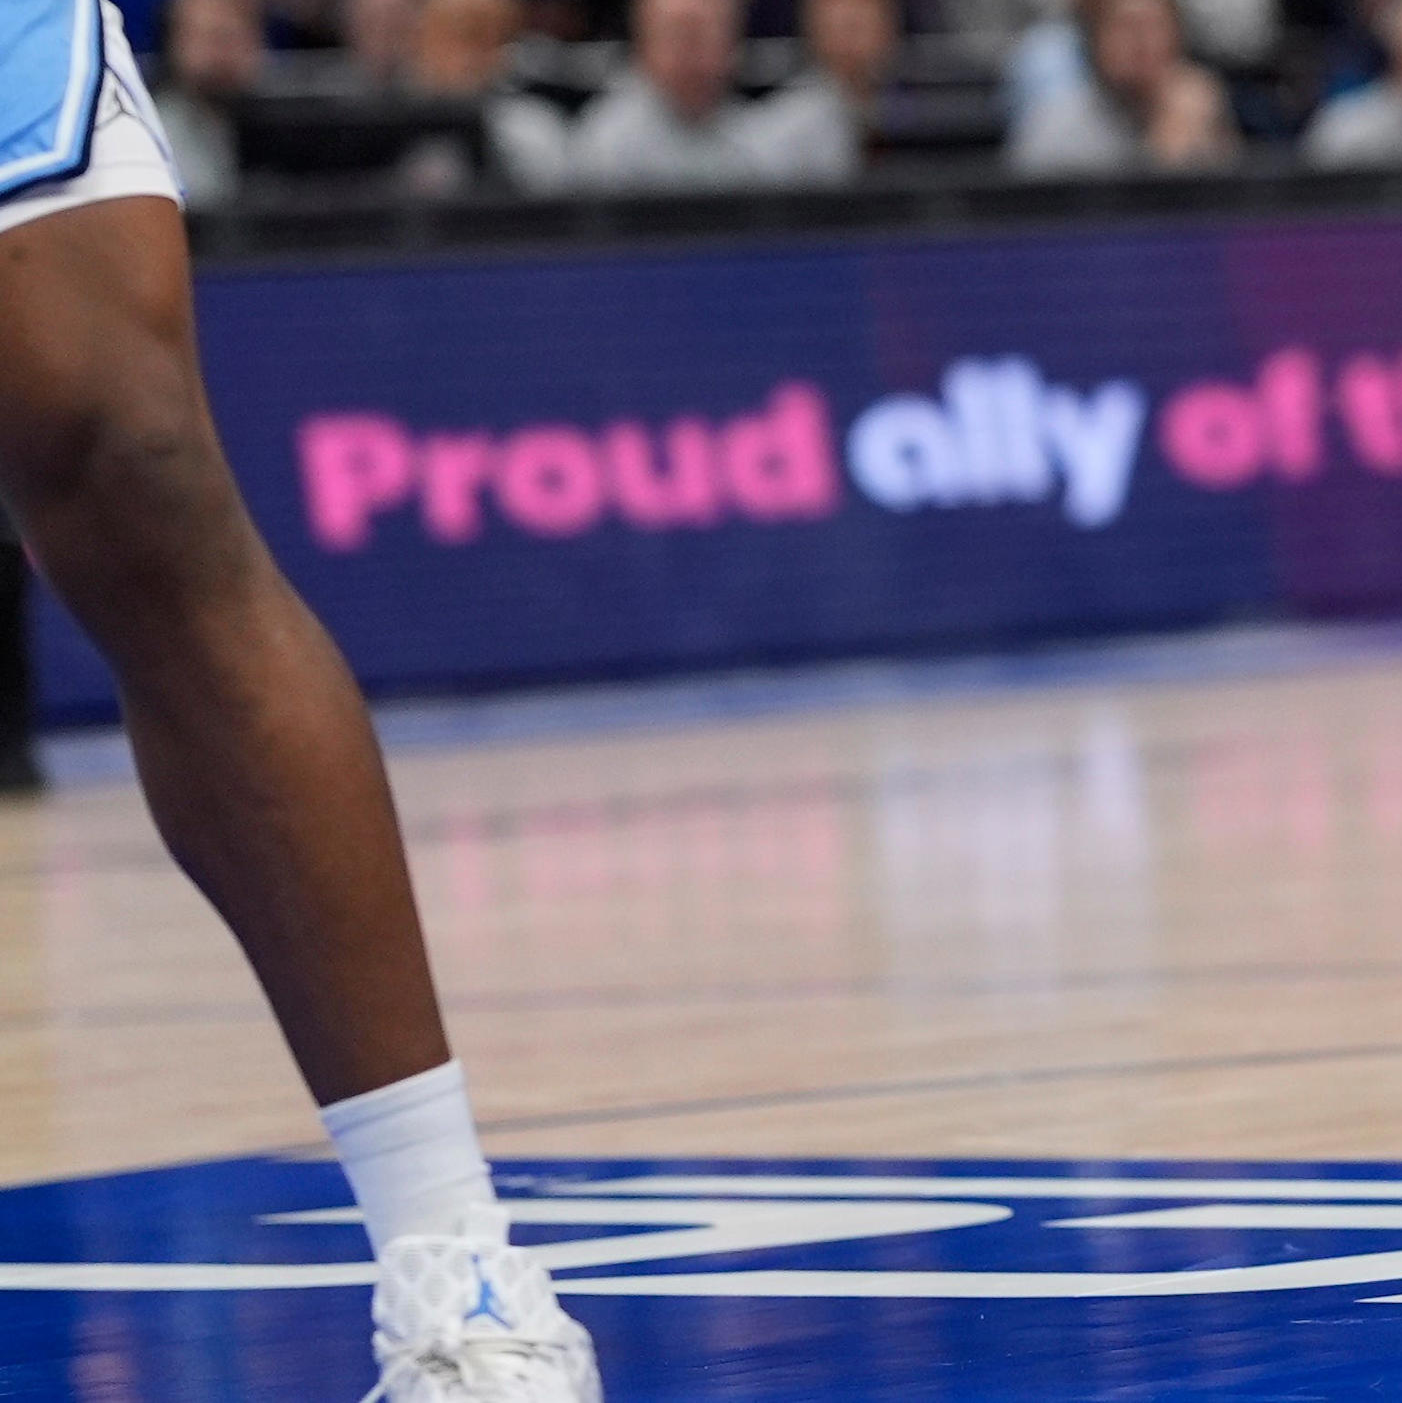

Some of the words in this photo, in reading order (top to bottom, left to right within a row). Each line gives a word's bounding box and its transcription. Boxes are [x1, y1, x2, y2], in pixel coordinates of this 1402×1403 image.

[297, 378, 838, 551] Proud
[846, 355, 1143, 527] ally
[1161, 345, 1321, 489] of
